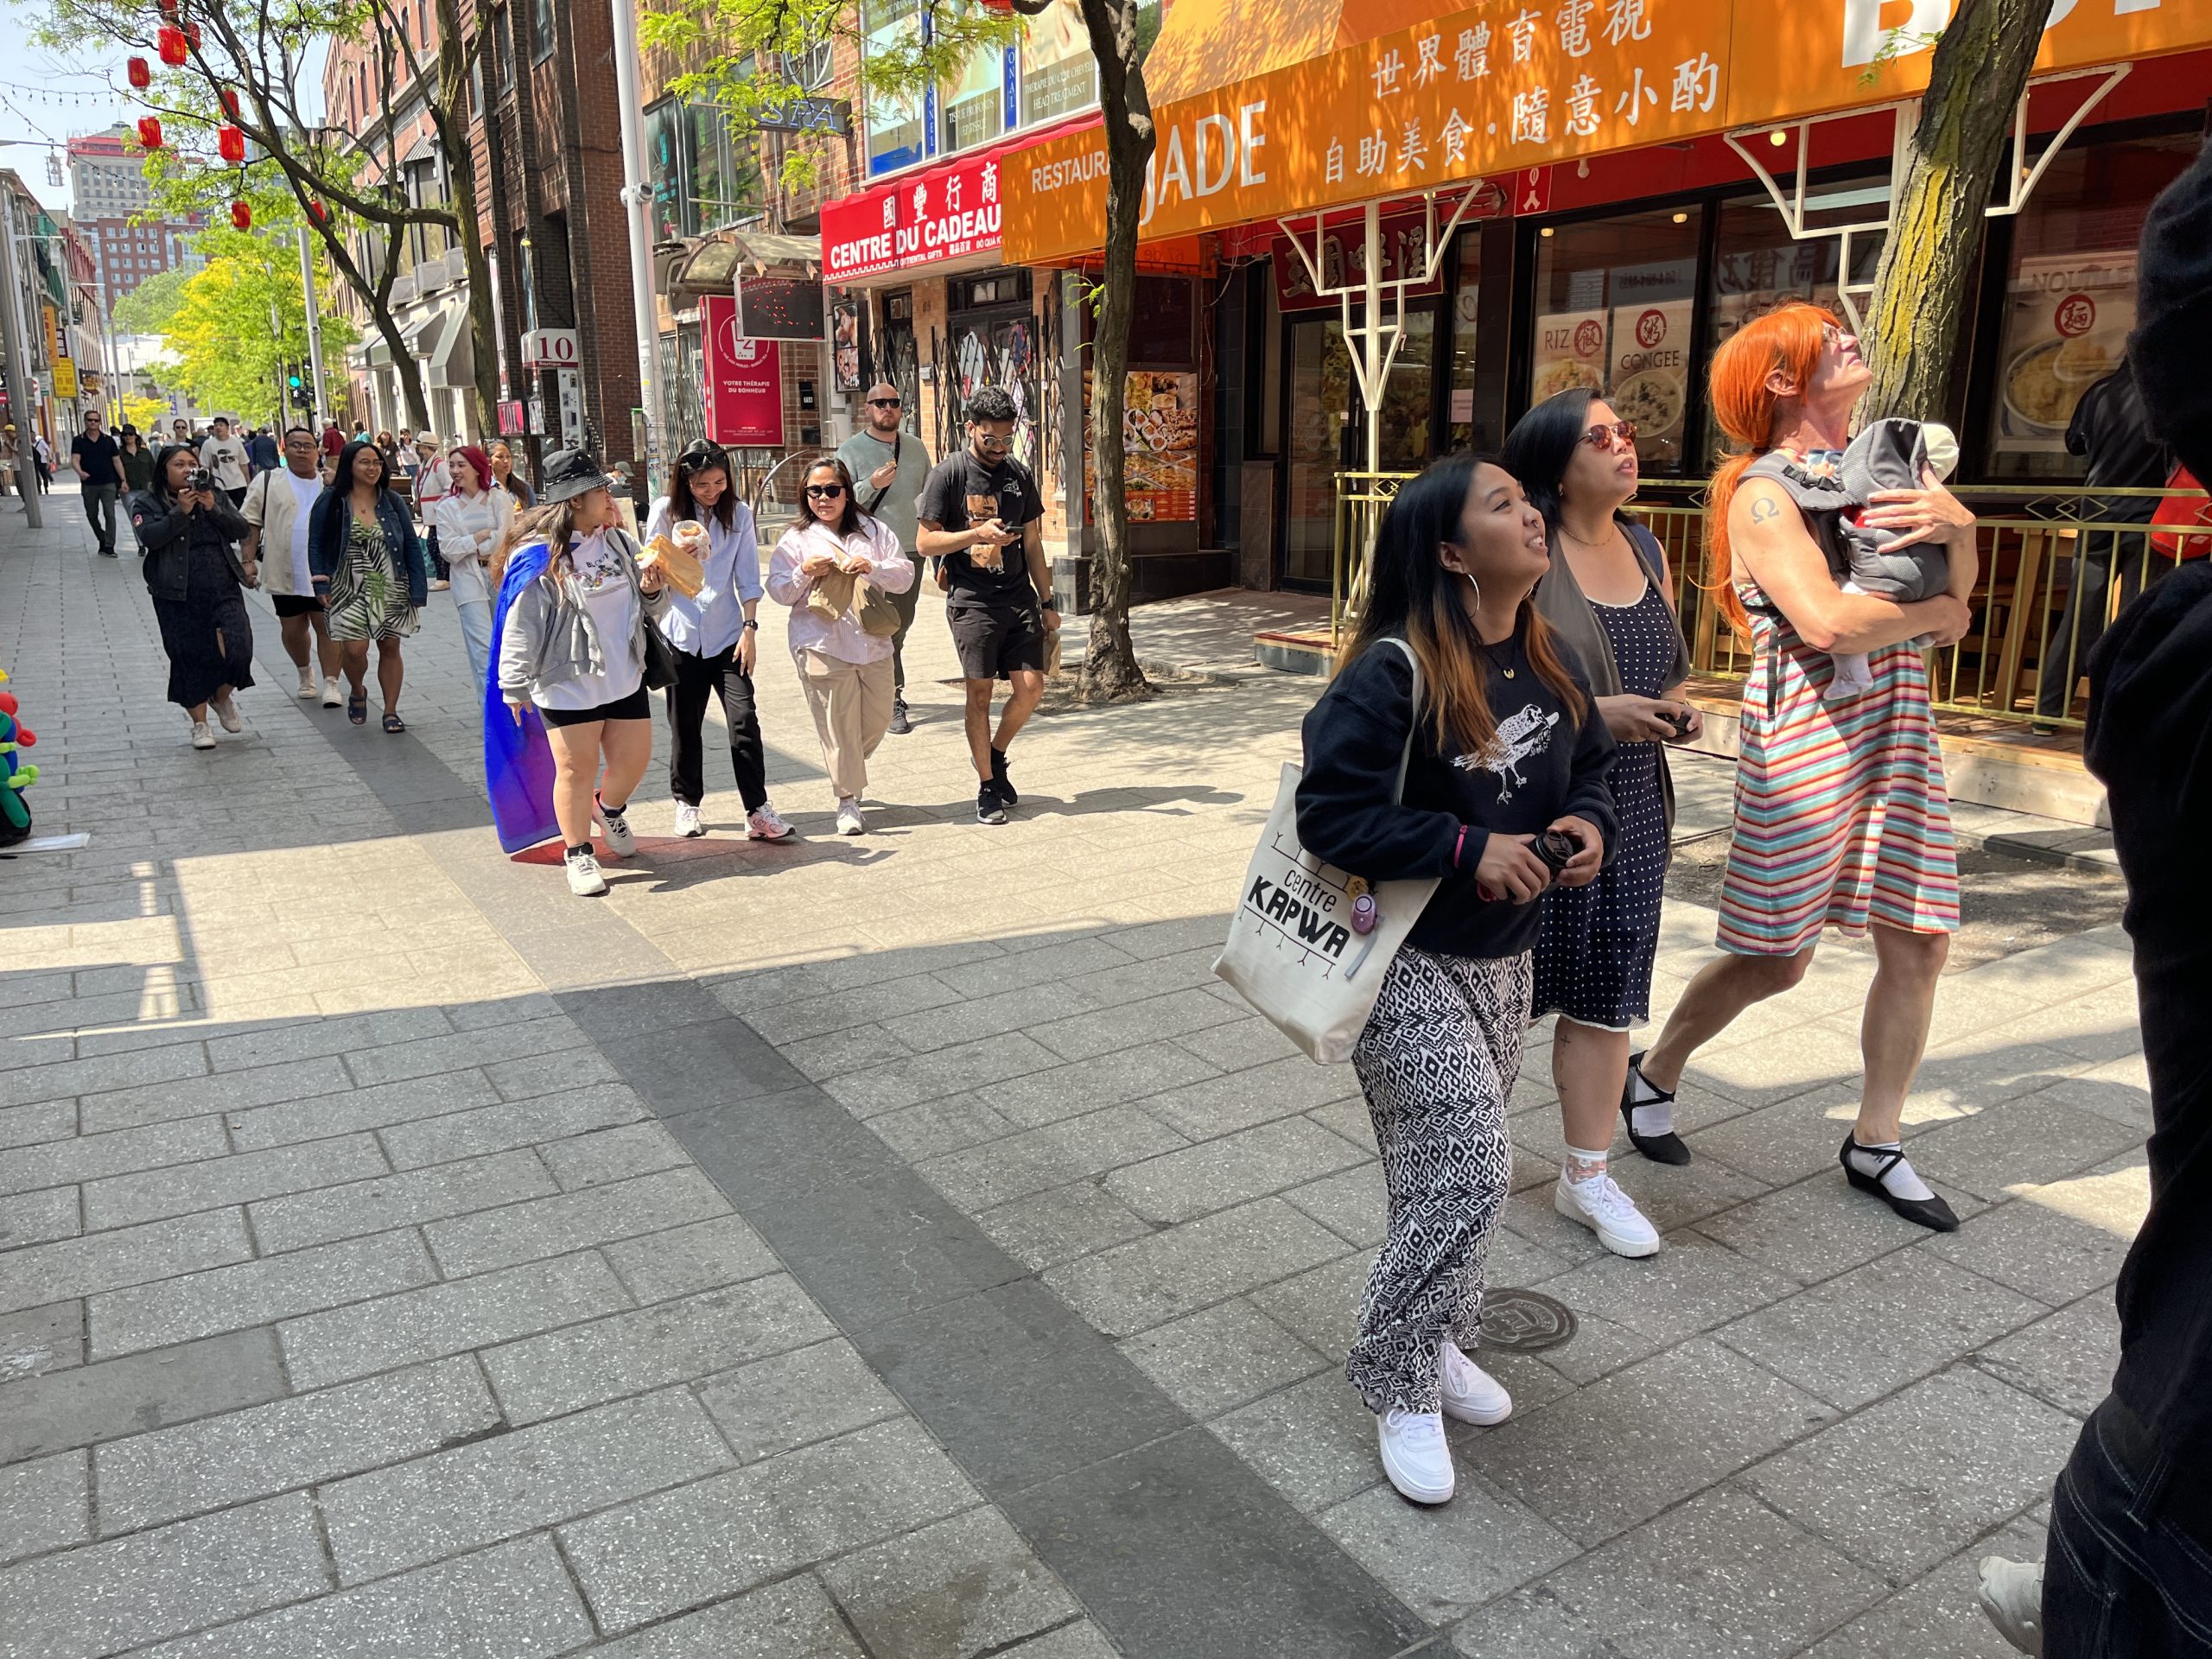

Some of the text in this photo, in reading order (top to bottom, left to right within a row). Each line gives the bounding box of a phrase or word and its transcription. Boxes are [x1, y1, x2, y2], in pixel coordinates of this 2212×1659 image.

[1048, 74, 1057, 87] DU
[1033, 81, 1086, 111] HEAD TREATMENT
[760, 96, 837, 129] SPA
[1140, 100, 1266, 226] JADE
[830, 203, 1002, 270] CENTRE DU CADEAU
[927, 249, 943, 260] GIFTS
[538, 336, 574, 360] 10
[1545, 329, 1570, 351] RIZ
[1620, 350, 1681, 371] CONGEE
[743, 378, 770, 387] THÉRAPIE
[1284, 868, 1338, 912] centre
